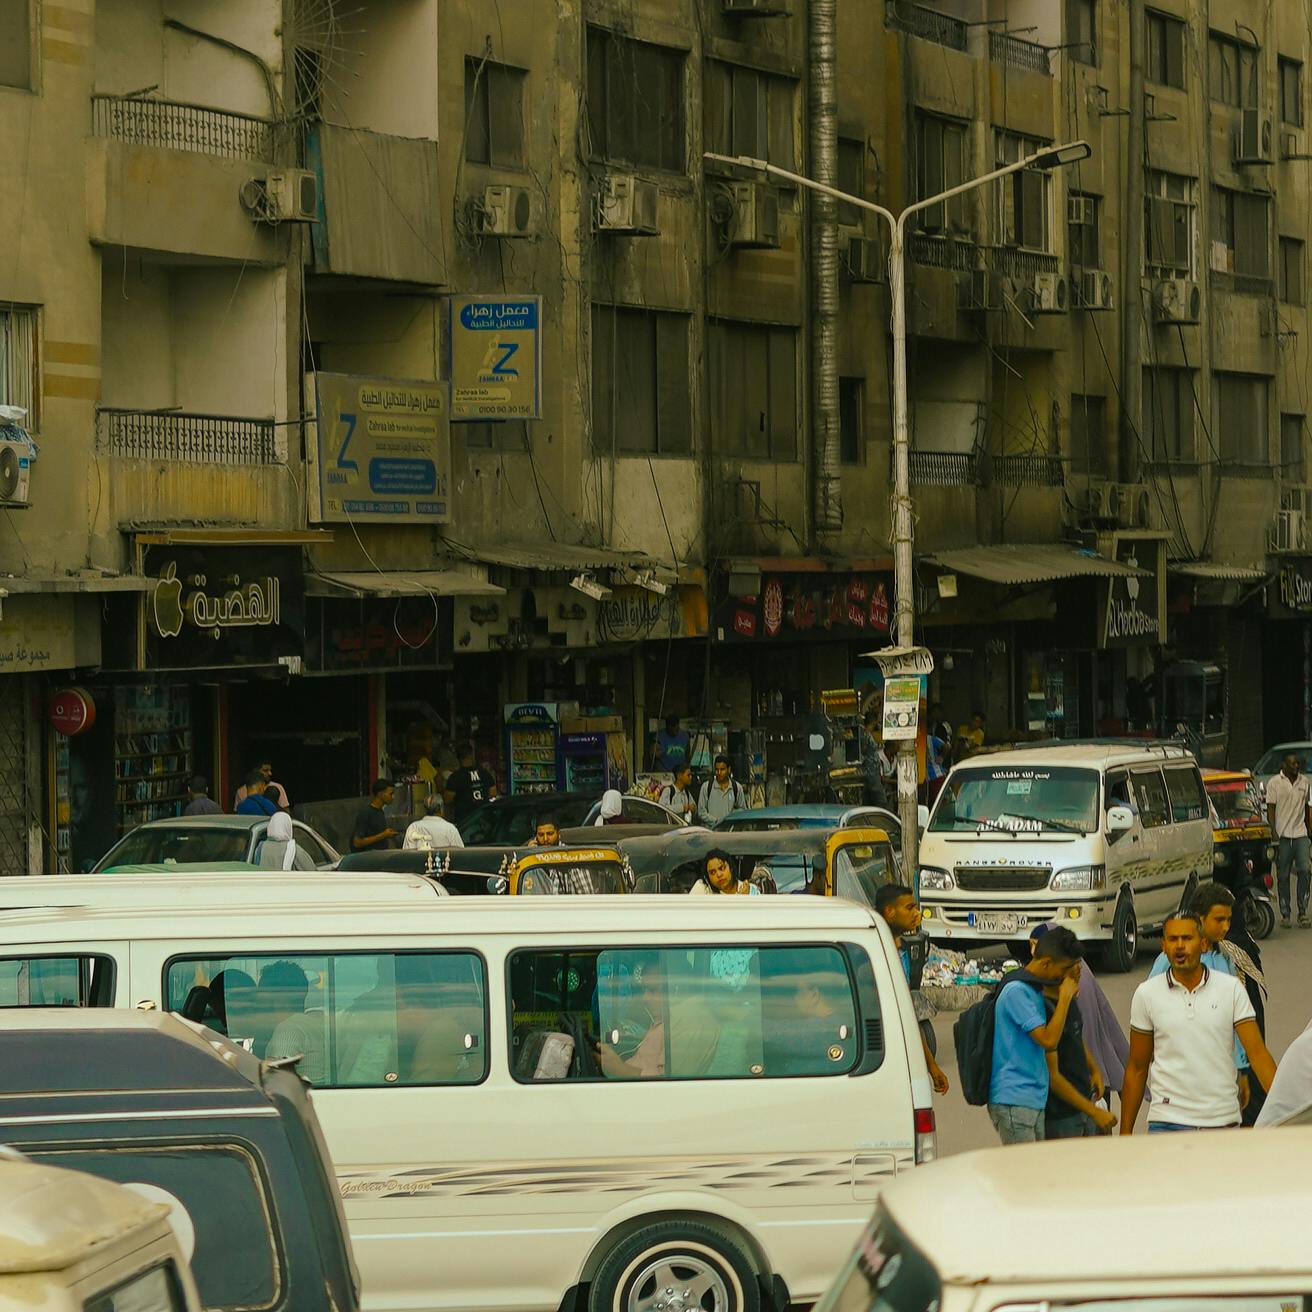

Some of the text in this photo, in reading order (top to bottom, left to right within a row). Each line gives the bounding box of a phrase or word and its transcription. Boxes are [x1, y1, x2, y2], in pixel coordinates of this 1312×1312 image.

[496, 304, 529, 318] معمل
[193, 574, 280, 640] الهضبة
[1008, 820, 1043, 831] ADAM
[385, 1178, 433, 1197] Dragon
